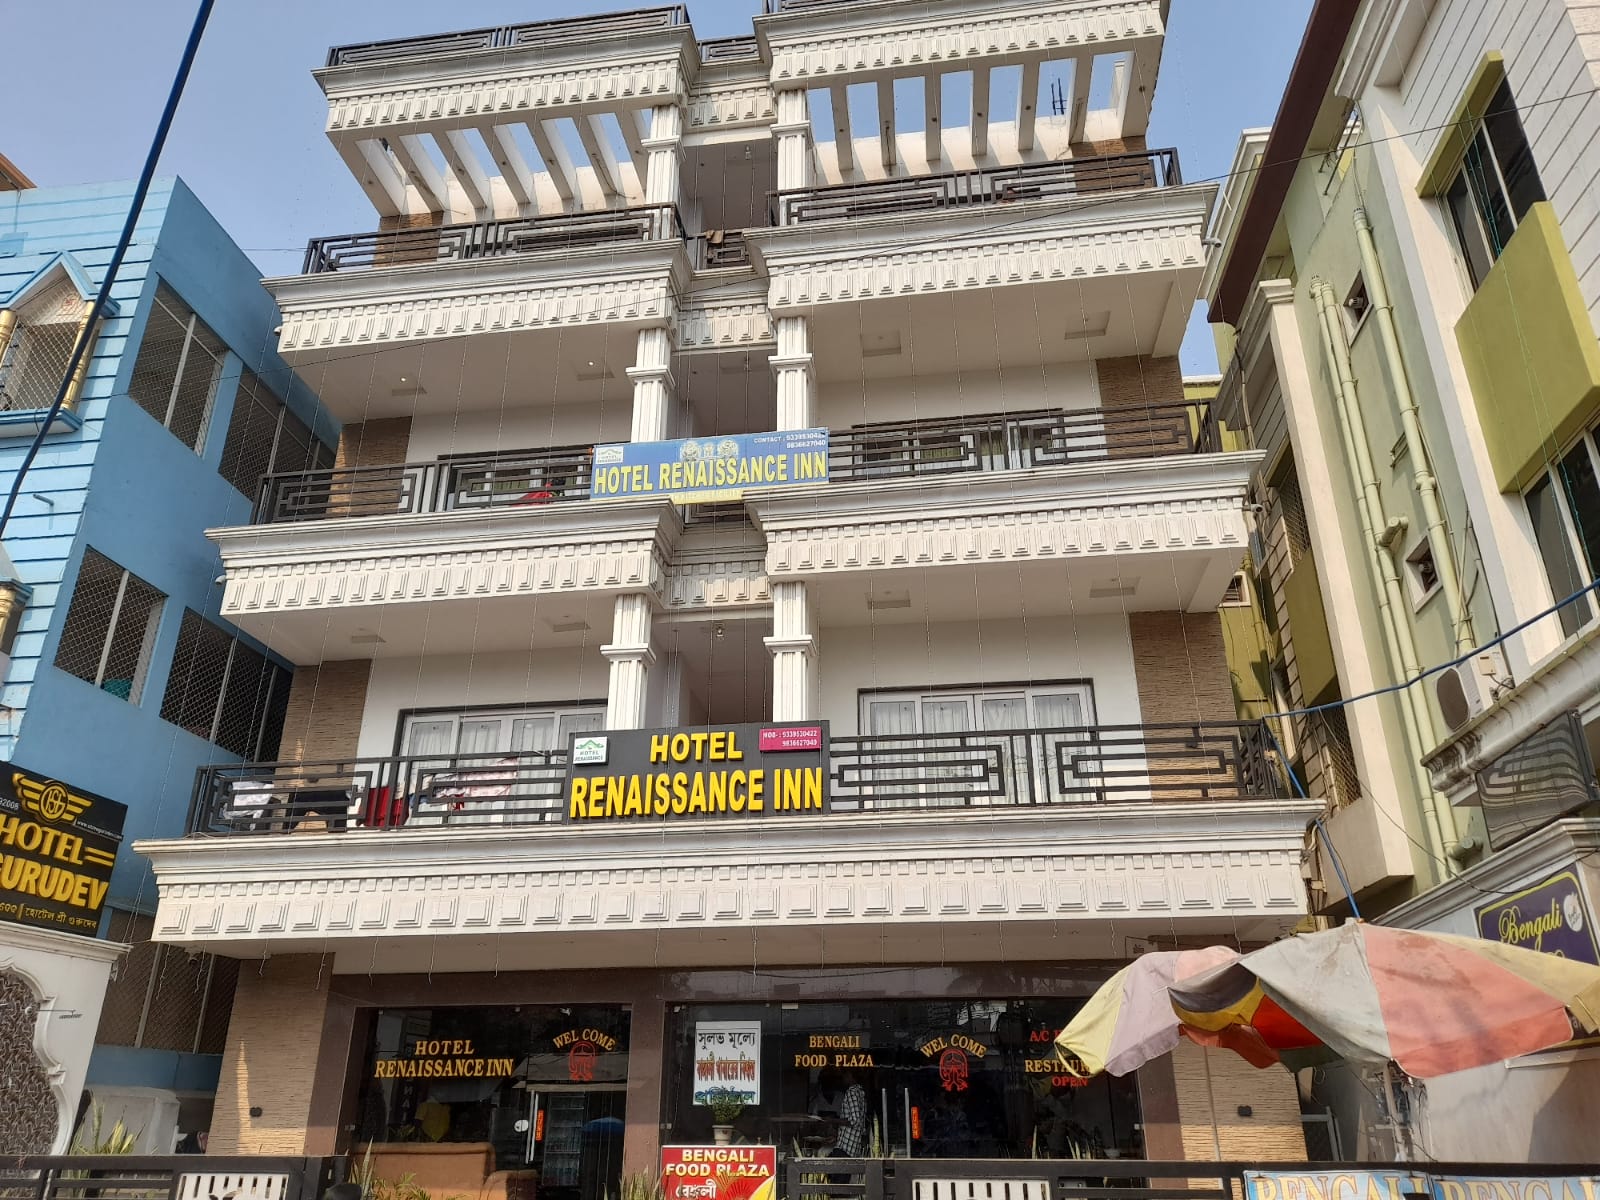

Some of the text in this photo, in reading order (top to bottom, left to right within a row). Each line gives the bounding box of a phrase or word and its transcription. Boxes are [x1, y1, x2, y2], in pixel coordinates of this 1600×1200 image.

[754, 436, 781, 444] CONTACT
[594, 450, 827, 494] HOTEL RENAISSANCE INN
[650, 731, 743, 763] HOTEL
[569, 767, 823, 818] RENAISSANCE INN
[0, 813, 83, 865] HOTEL
[0, 852, 109, 910] URUDEV
[1498, 897, 1563, 952] Bengali
[414, 1040, 475, 1056] HOTEL
[698, 1032, 726, 1050] সুলভ
[809, 1035, 861, 1048] BENGALI
[374, 1058, 514, 1079] RENAISSANCE INN
[795, 1054, 874, 1068] FOOD PLAZA
[1051, 1075, 1088, 1087] OPEN
[681, 1149, 755, 1162] BENGALI
[665, 1163, 770, 1177] FOOD PLAZA
